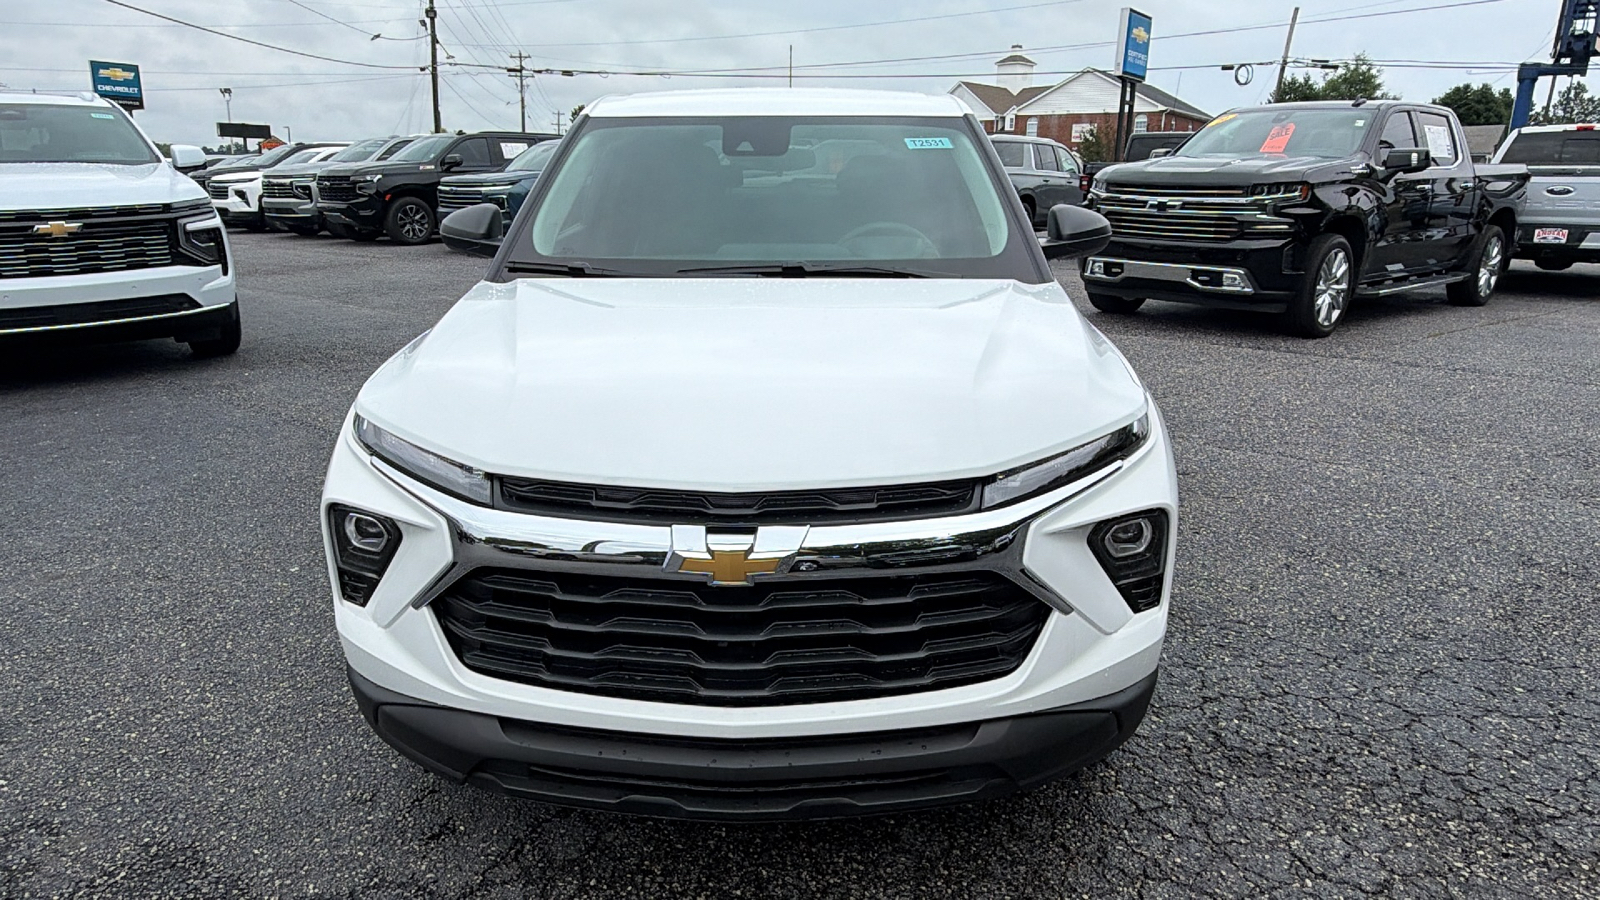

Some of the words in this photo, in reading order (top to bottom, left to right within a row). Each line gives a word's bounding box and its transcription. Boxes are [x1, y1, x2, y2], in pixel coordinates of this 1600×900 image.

[97, 84, 139, 93] CHEVROLET
[1269, 128, 1291, 140] SALE
[910, 139, 945, 147] T2531
